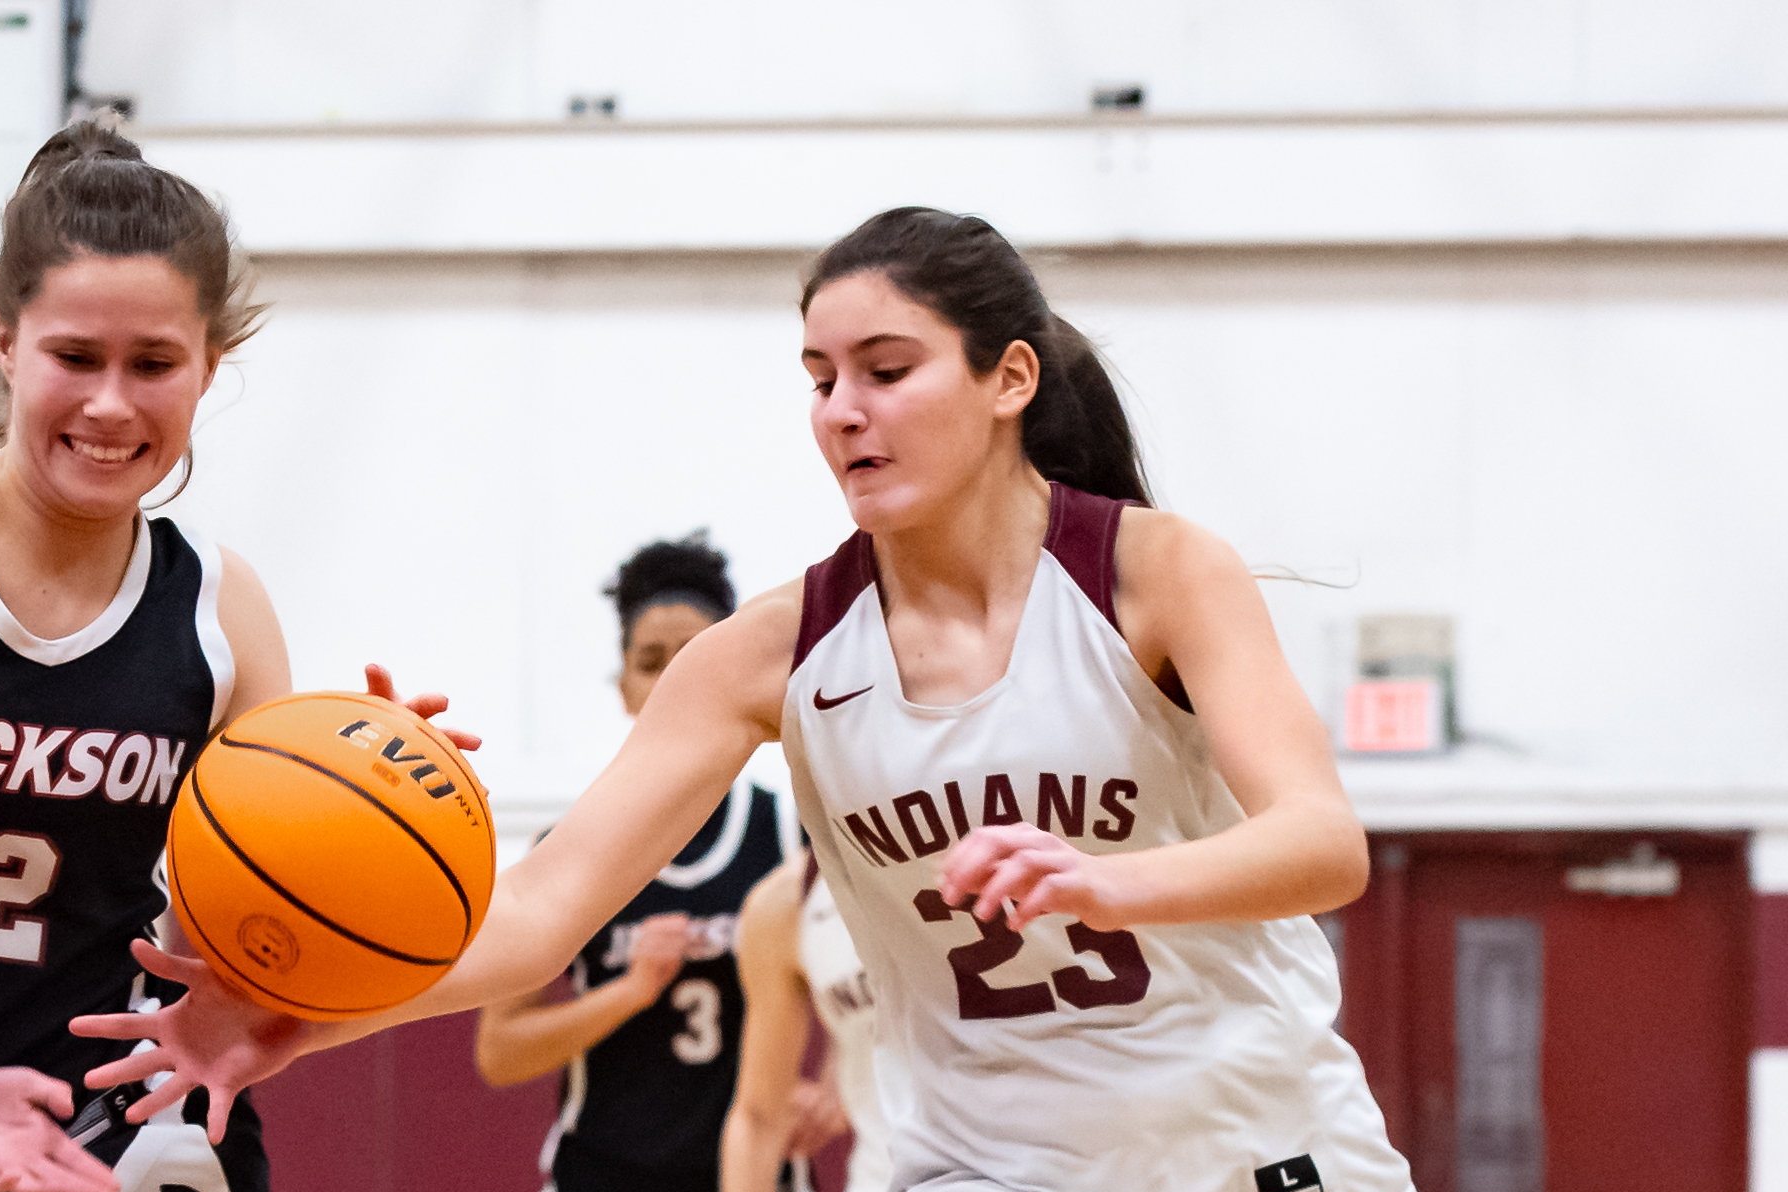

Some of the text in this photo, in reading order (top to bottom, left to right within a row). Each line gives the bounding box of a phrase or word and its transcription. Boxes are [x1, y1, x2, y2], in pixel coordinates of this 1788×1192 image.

[336, 719, 457, 799] EVO
[832, 772, 1139, 868] NDIANS
[912, 888, 1152, 1020] 23
[671, 977, 723, 1065] 3
[1279, 1166, 1300, 1188] L
